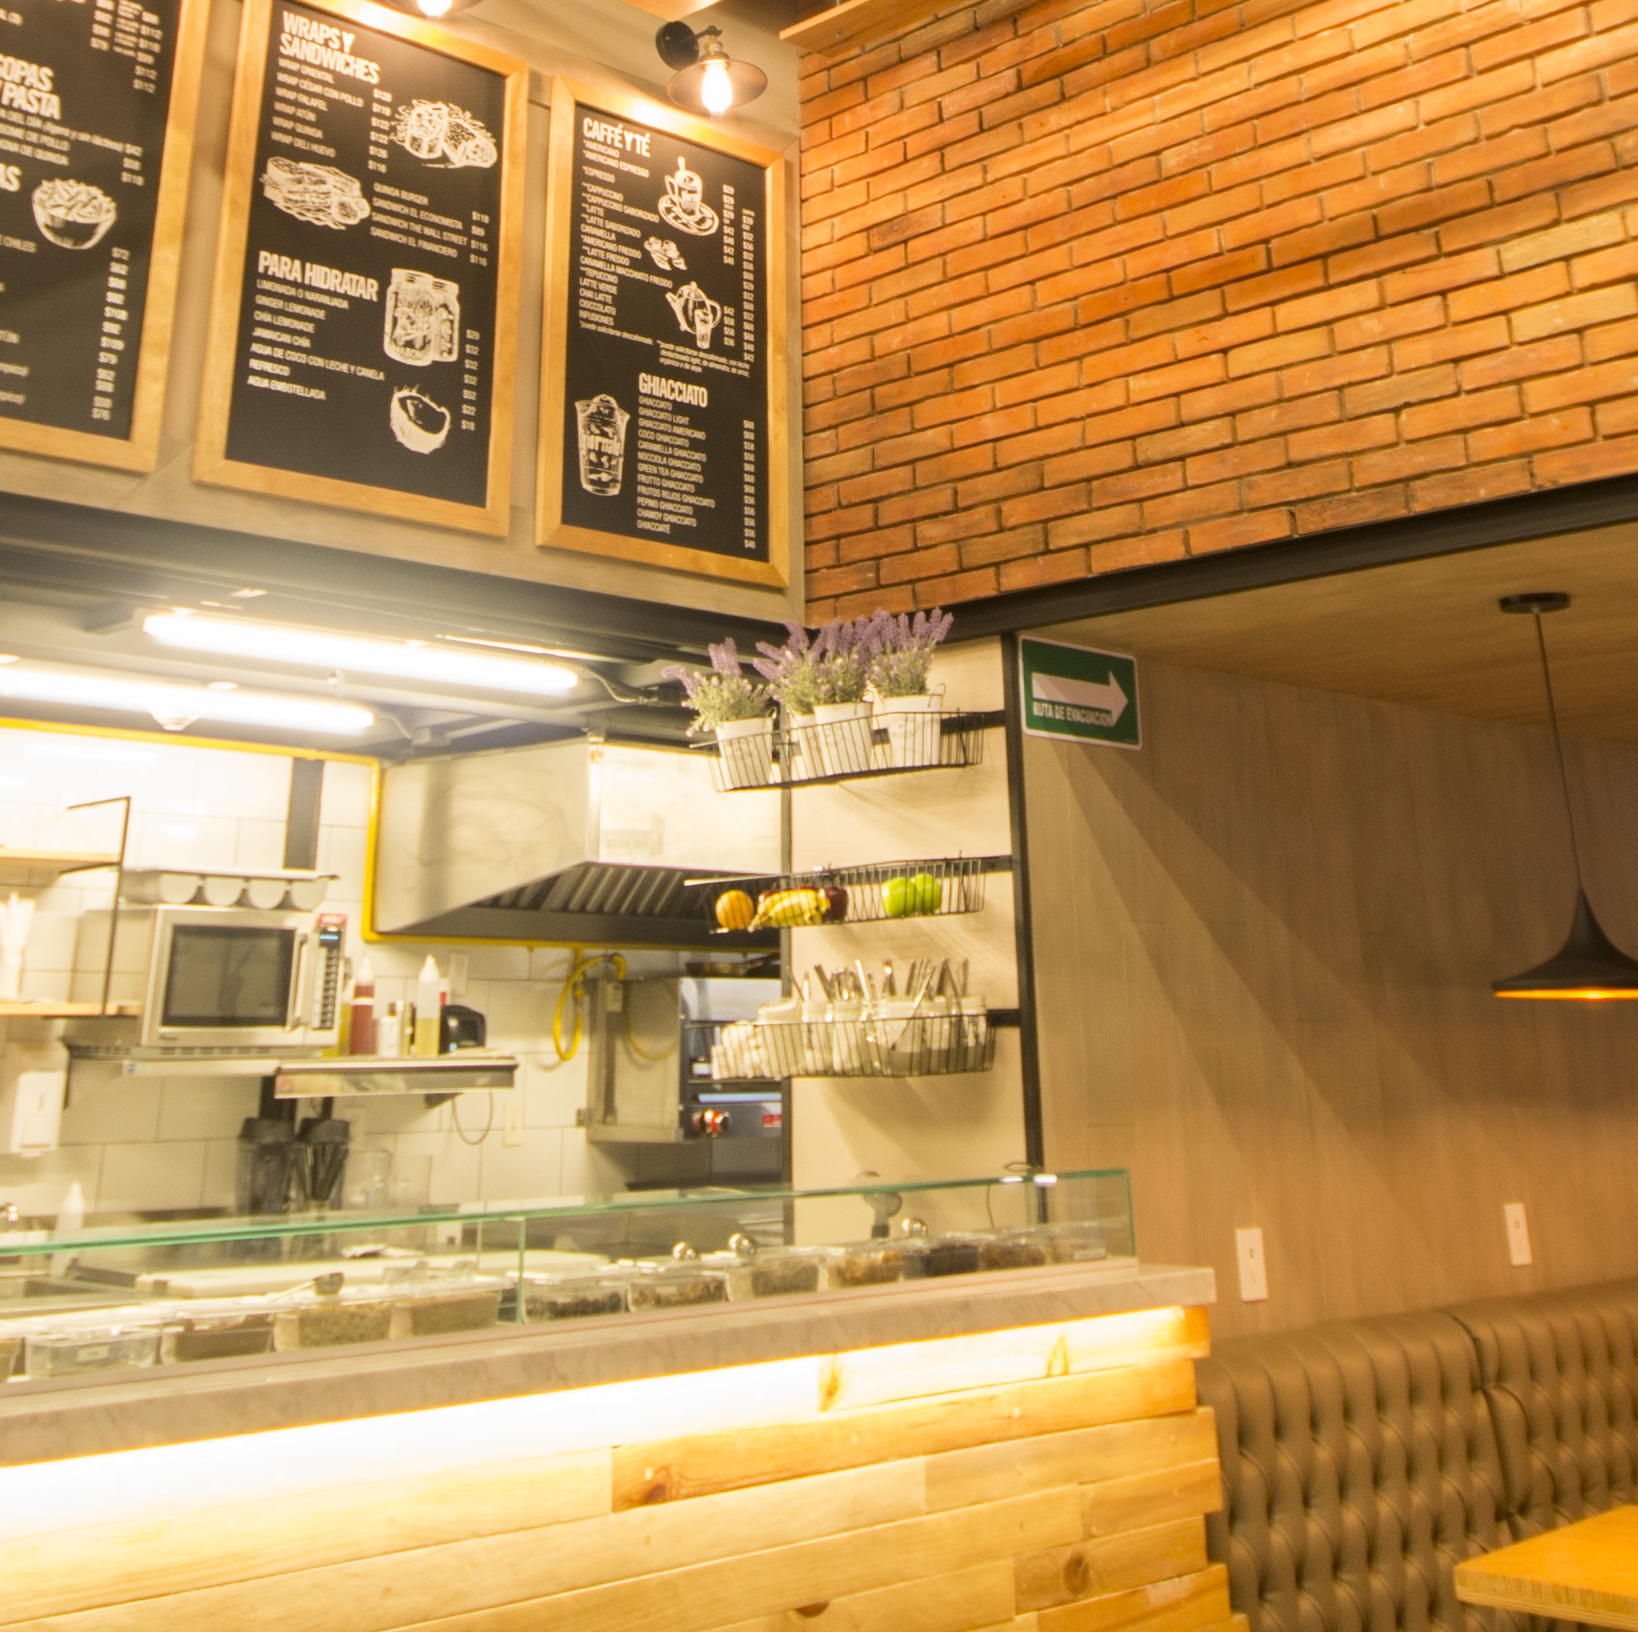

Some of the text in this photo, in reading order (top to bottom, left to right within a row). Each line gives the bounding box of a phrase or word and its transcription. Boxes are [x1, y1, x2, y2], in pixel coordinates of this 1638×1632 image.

[280, 9, 355, 55] WRAPS Y
[277, 56, 300, 73] WRAP
[278, 30, 381, 86] SANDWICHES
[0, 80, 64, 121] PASTA
[274, 85, 297, 102] WRAP
[275, 70, 298, 87] WRAP
[324, 86, 339, 100] CON
[339, 91, 364, 109] POLLO
[273, 99, 295, 116] WRAP
[271, 114, 294, 131] WRAP
[583, 111, 650, 157] CAFFÉ Y TÉ
[270, 129, 293, 146] WRAP
[372, 195, 409, 215] SANDWICH
[373, 181, 428, 207] QUINOA BURGER
[369, 225, 407, 245] SANDWICH
[371, 210, 468, 247] SANDWICH THE WALL STREET
[256, 277, 296, 298] LIMONADA
[257, 249, 379, 303] PARA HIDRATAR
[254, 293, 326, 321] GINGER LEMONADE
[251, 325, 292, 345] JAMAICAN
[271, 313, 315, 334] LEMONADE
[248, 358, 290, 377] REFRESCO
[249, 341, 272, 356] AGUA
[272, 346, 284, 359] DE
[285, 349, 307, 364] COCO
[307, 354, 324, 368] CON
[324, 358, 349, 374] LECHE
[355, 365, 385, 382] CANELA
[246, 374, 326, 401] AGUA EMBOTELLADA
[638, 371, 708, 408] GHIACCIATO
[1032, 701, 1055, 719] RUTA
[1054, 703, 1065, 721] DE
